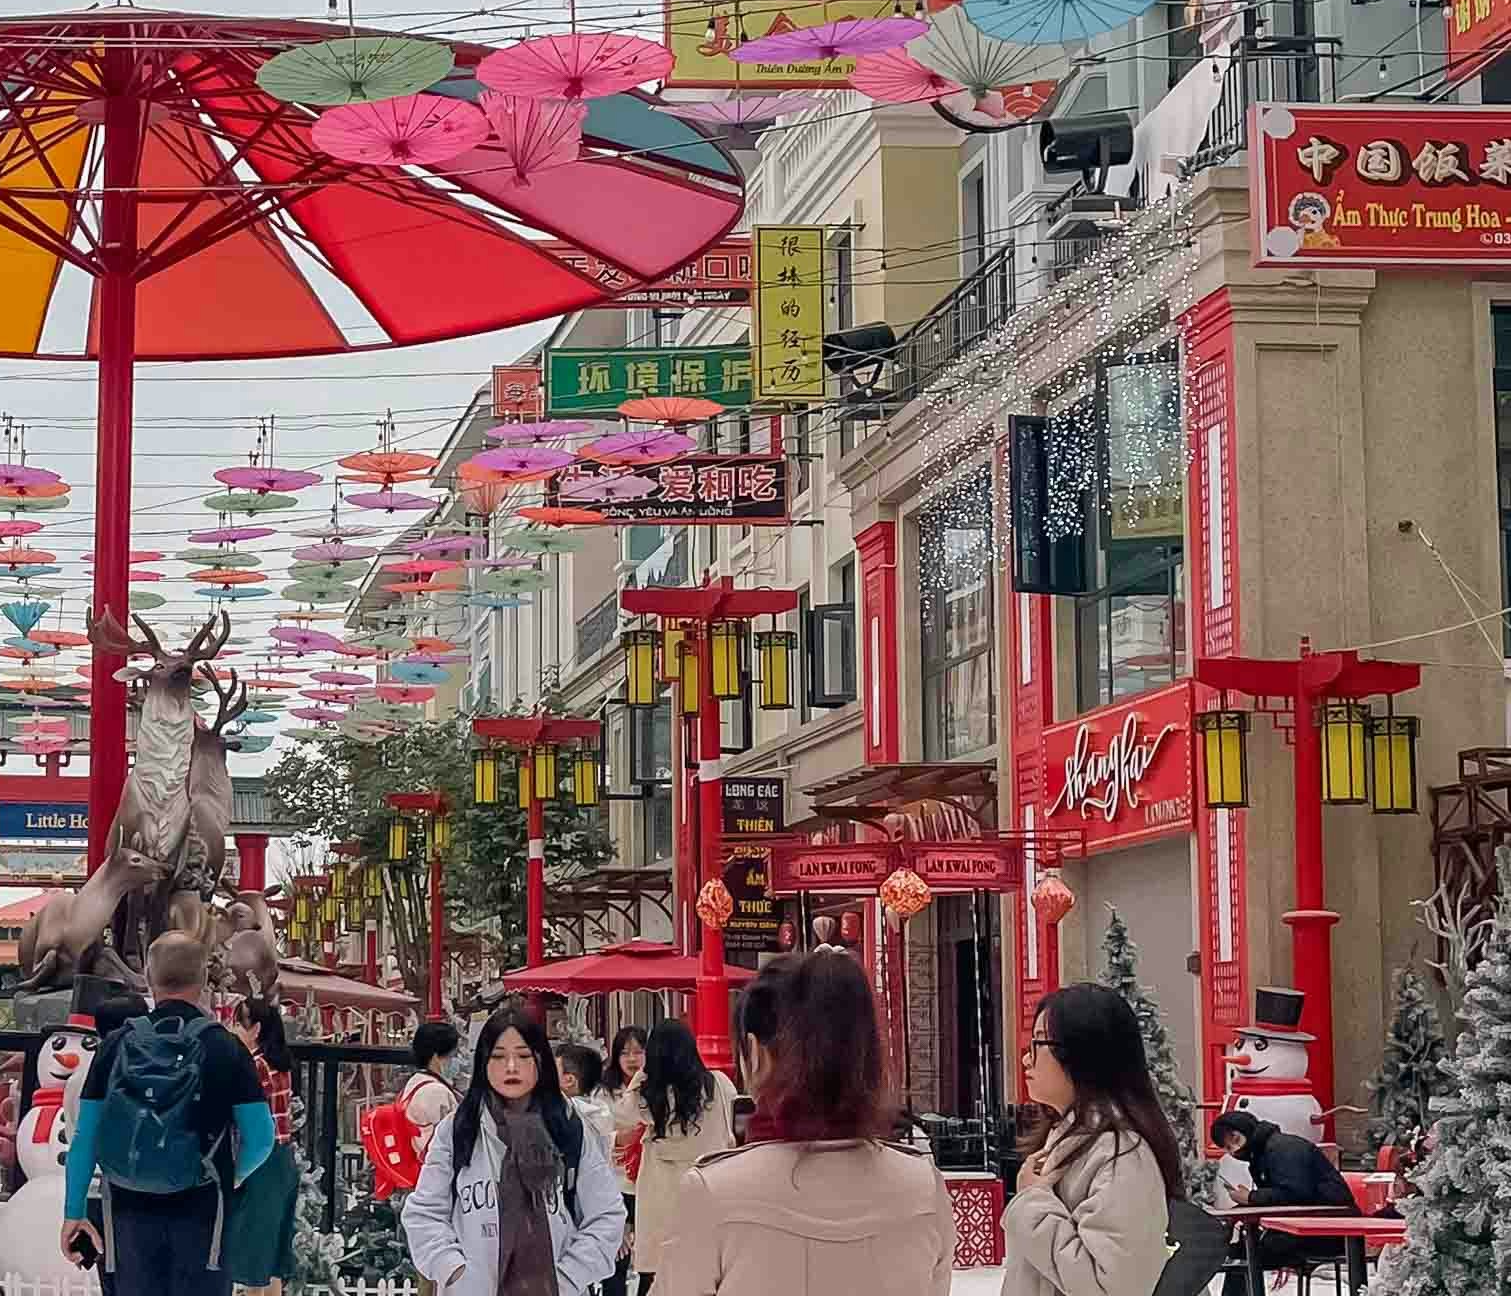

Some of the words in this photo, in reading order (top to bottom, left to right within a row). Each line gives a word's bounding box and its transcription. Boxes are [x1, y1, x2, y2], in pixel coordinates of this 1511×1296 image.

[1332, 189, 1362, 227] Ẩm
[1365, 202, 1408, 234] Thực
[1412, 203, 1462, 233] Trung
[1465, 204, 1501, 228] Hoa
[25, 811, 66, 829] Little
